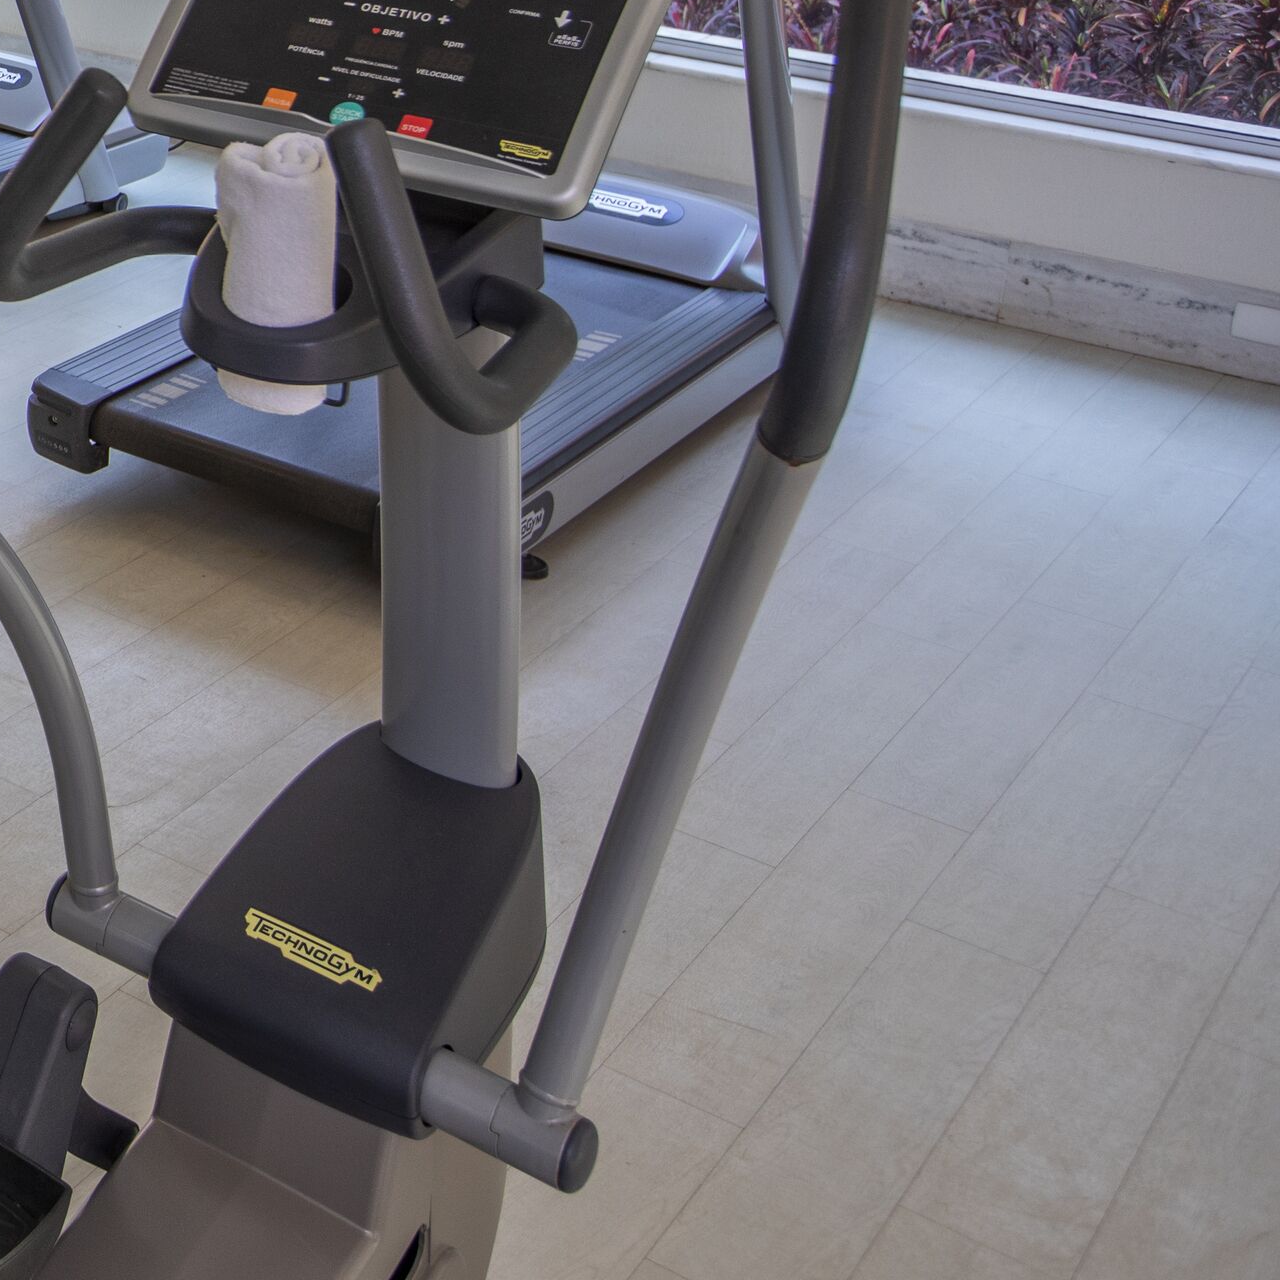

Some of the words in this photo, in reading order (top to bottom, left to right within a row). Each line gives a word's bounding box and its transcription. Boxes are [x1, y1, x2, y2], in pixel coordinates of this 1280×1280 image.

[360, 3, 432, 22] OBJETIVO
[509, 9, 540, 18] CONFIRMA
[308, 17, 334, 26] watts
[382, 28, 404, 38] BPM
[443, 40, 465, 49] spm
[553, 38, 579, 47] PERFIS
[288, 44, 325, 56] POTÊNCIA
[360, 71, 401, 84] DIFICULDADE
[416, 68, 465, 82] VELOCIDADE
[335, 107, 362, 117] QUICK
[401, 124, 426, 133] STOP
[502, 142, 550, 158] TECHNOGYM
[591, 194, 662, 214] HNOGYM
[250, 912, 376, 986] TECHNOGYM
